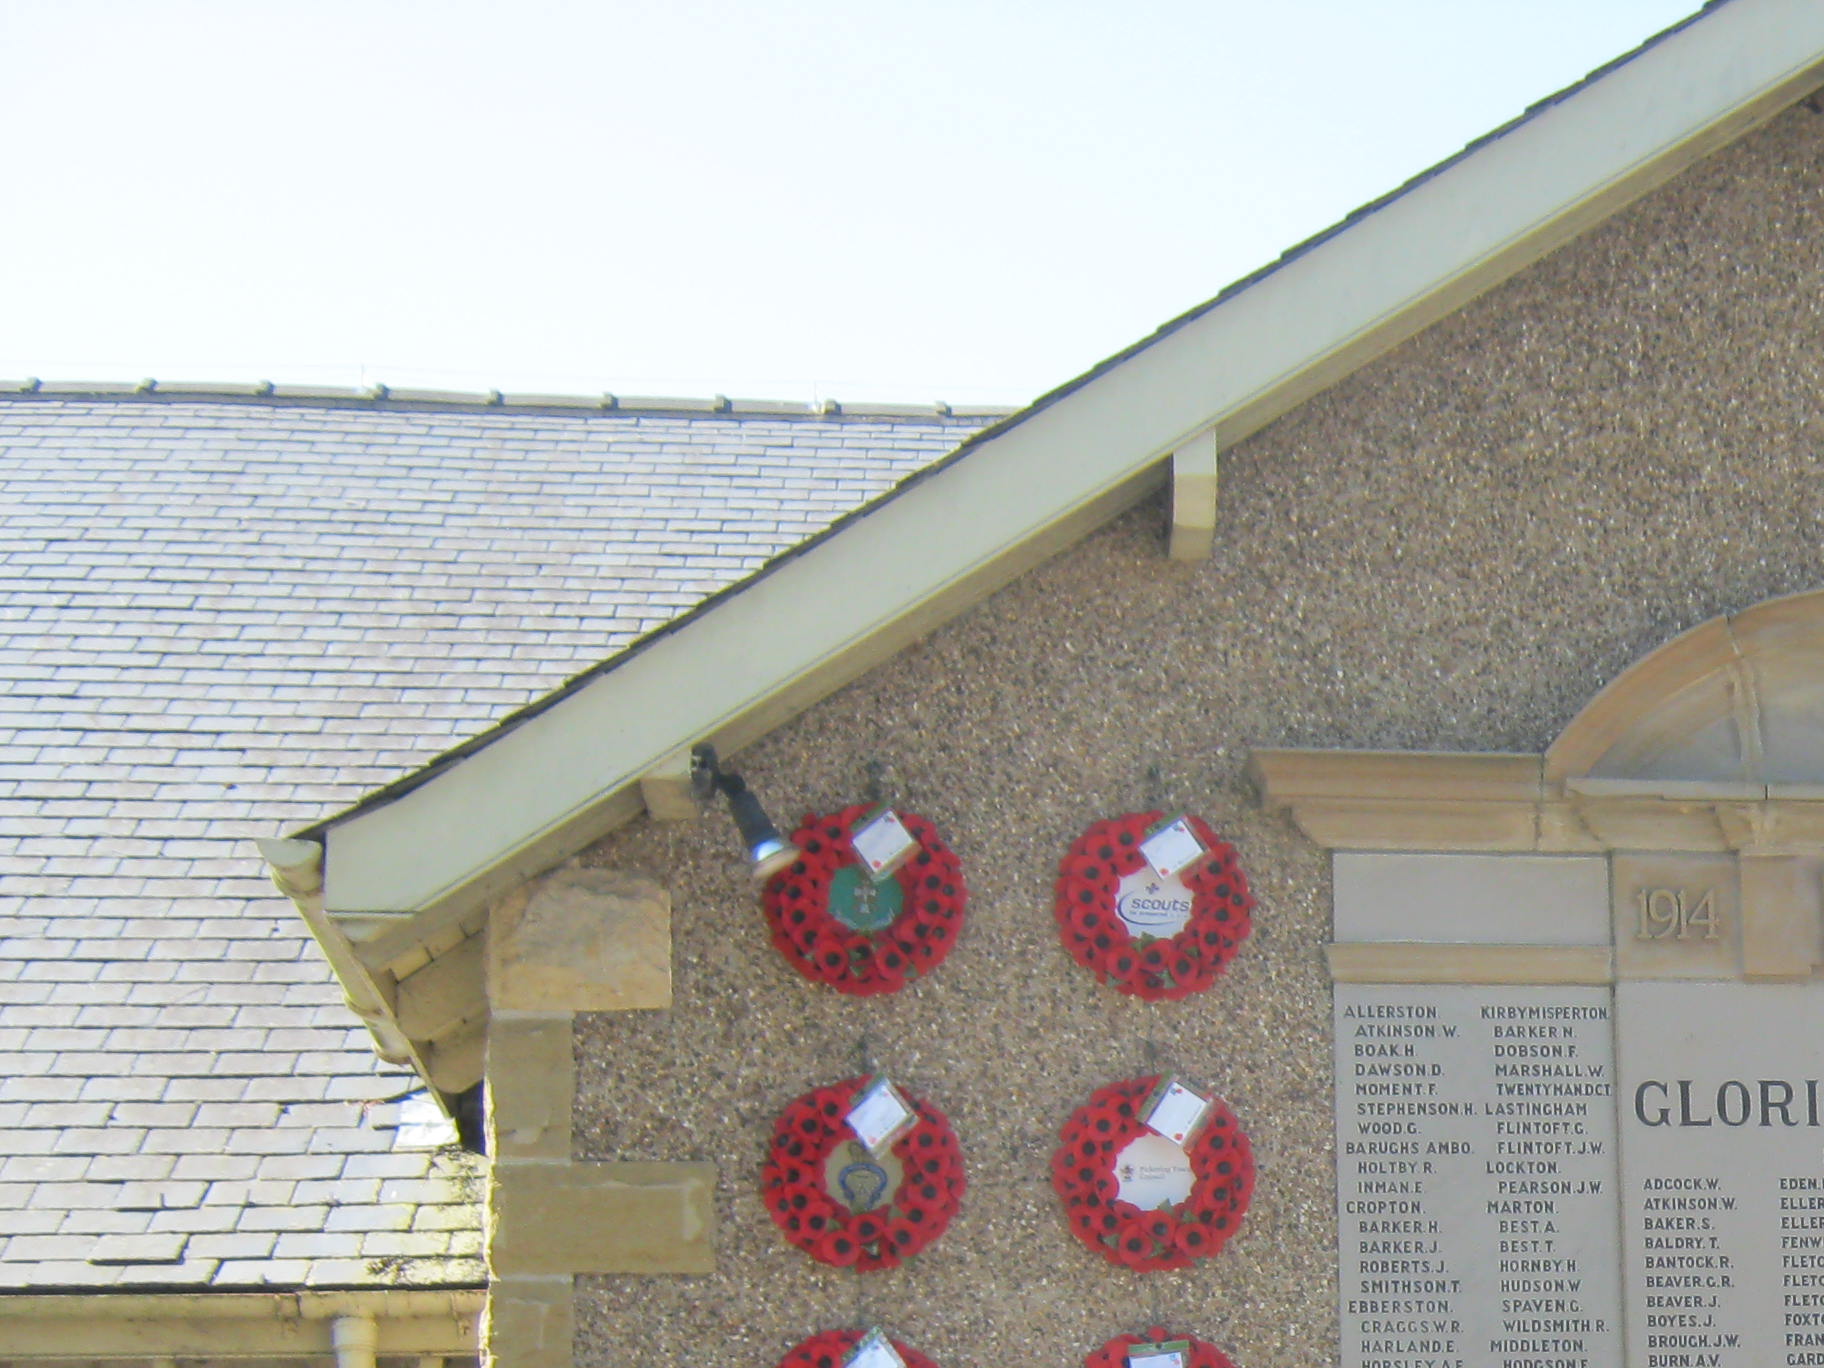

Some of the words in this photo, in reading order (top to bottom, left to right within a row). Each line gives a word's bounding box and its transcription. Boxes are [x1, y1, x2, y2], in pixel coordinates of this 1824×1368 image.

[1131, 898, 1190, 911] scouts
[1636, 888, 1720, 939] 1914
[1485, 1101, 1587, 1116] LASTINGHAM
[1346, 1140, 1419, 1156] BARUGHS
